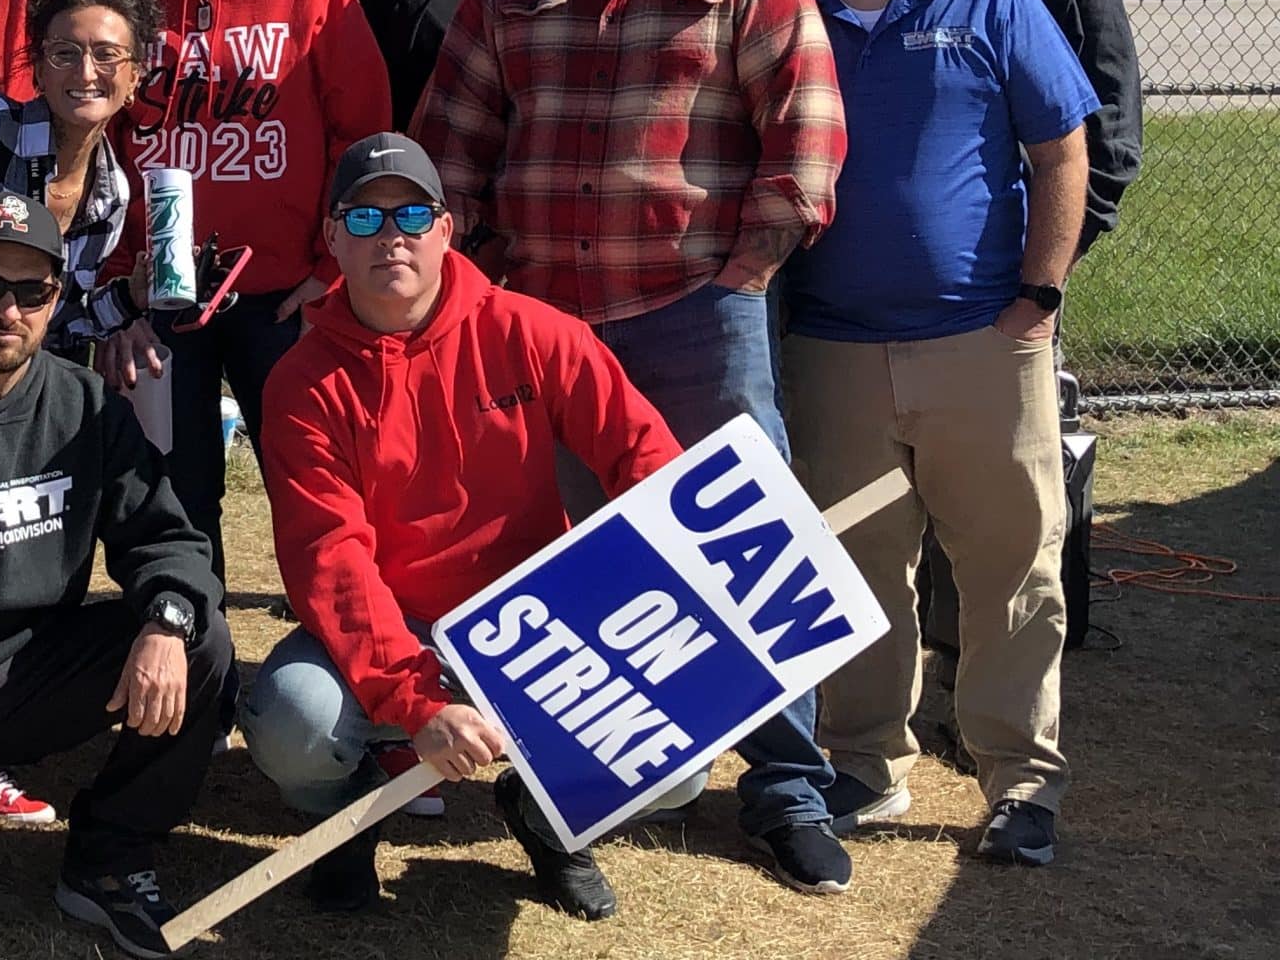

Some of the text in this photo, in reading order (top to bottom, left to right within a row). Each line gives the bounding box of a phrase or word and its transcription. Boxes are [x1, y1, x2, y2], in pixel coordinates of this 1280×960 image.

[135, 66, 280, 134] Strike
[132, 121, 288, 181] 2023
[14, 517, 63, 542] DIVISION
[670, 444, 854, 665] UAW
[599, 590, 718, 686] ON
[468, 594, 695, 788] STRIKE
